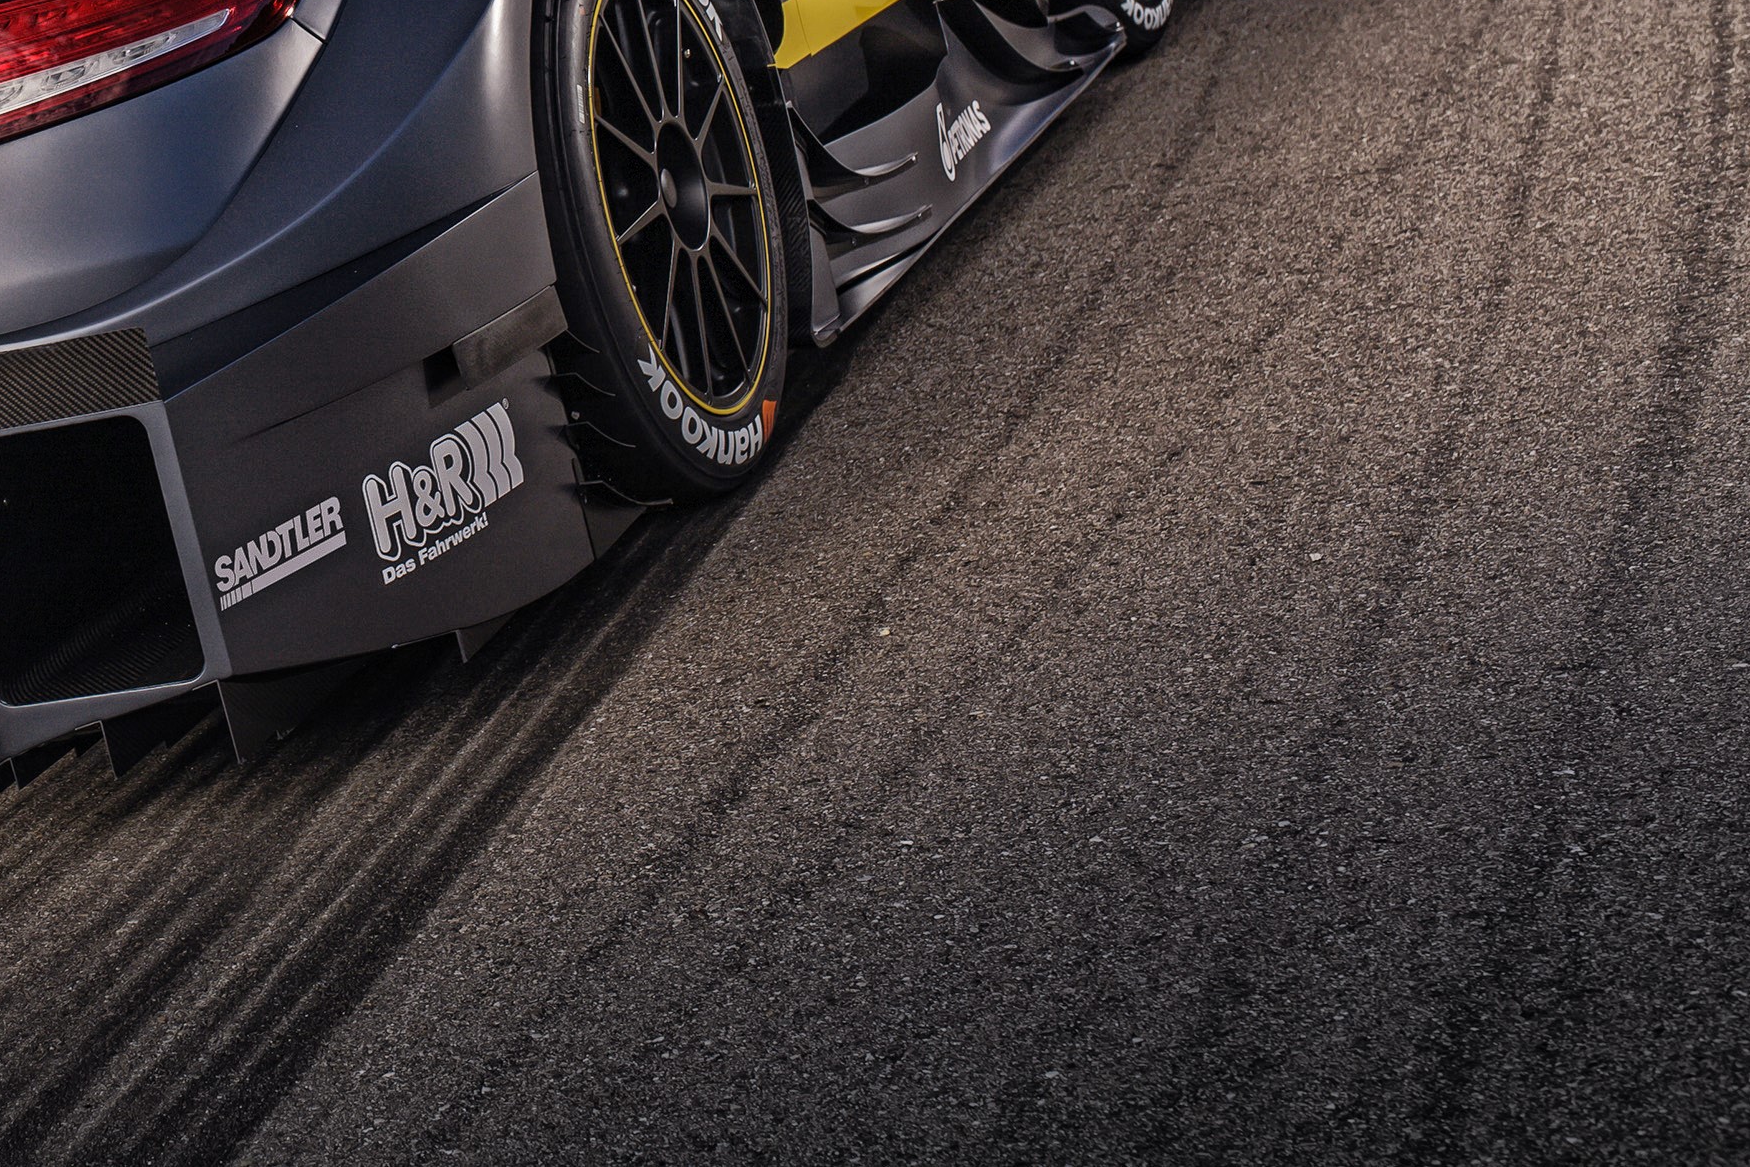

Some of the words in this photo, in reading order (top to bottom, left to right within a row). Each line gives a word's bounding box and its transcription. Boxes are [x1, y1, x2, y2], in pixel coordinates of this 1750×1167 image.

[948, 100, 991, 165] PETRONAS
[362, 433, 484, 562] H&R
[214, 496, 344, 593] SANDTLER
[381, 558, 417, 585] Das
[417, 511, 489, 566] Fahrwerk!
